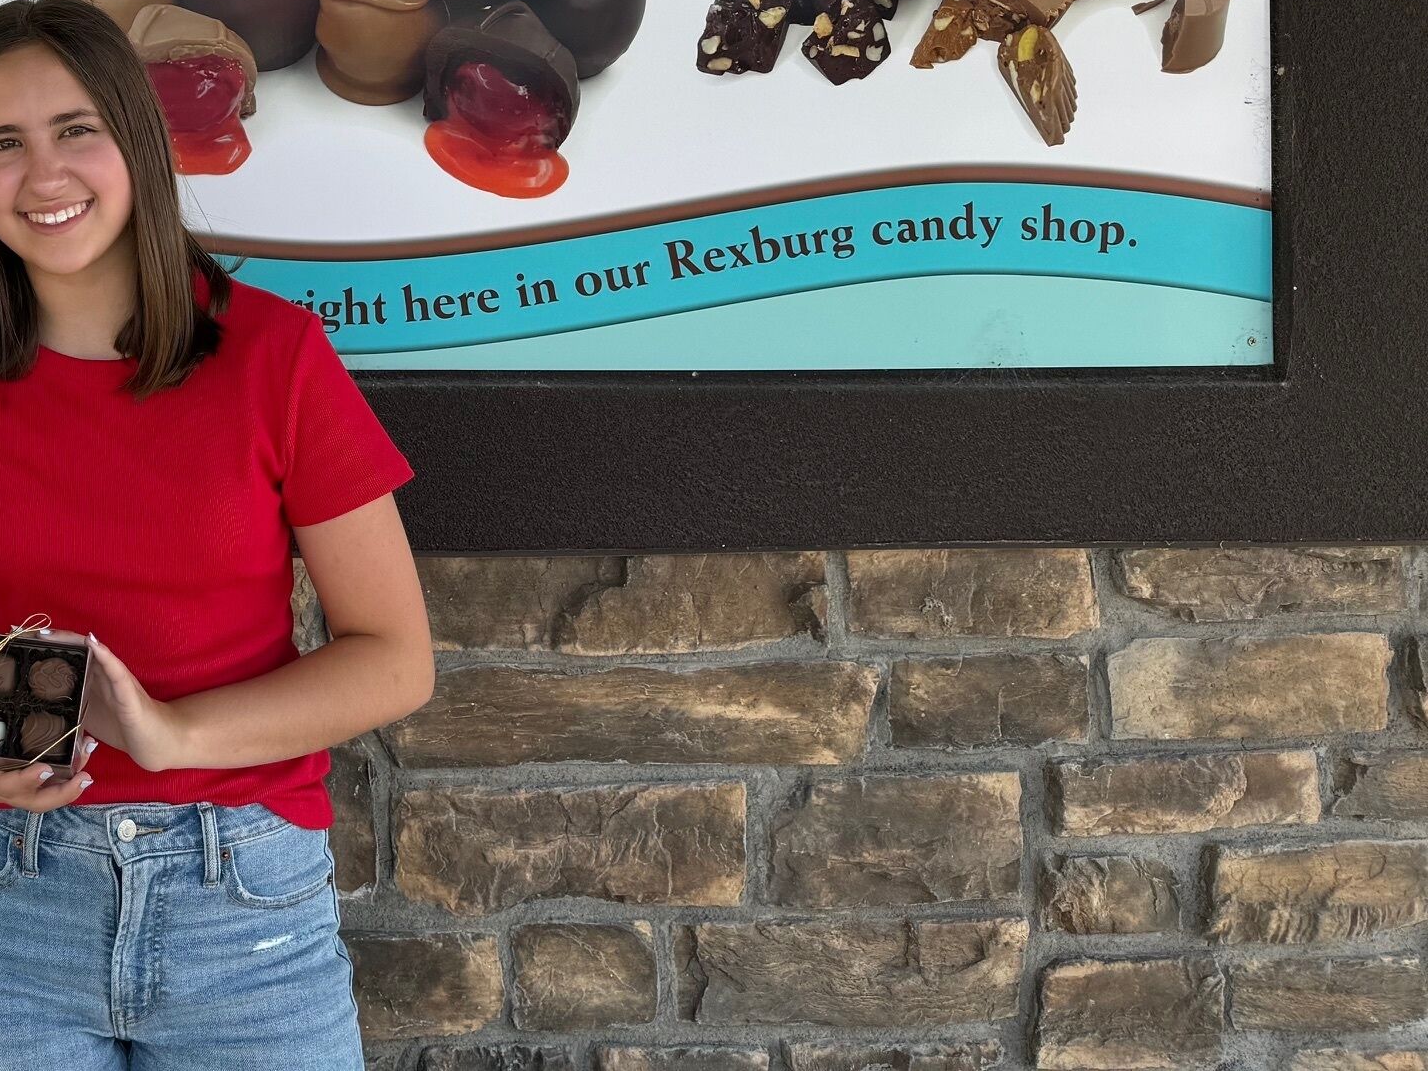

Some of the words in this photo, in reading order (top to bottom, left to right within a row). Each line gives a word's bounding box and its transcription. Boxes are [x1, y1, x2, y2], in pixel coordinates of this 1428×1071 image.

[401, 283, 500, 323] here
[515, 273, 560, 309] in
[574, 259, 650, 297] our
[663, 225, 855, 280] Rexburg
[871, 200, 1003, 249] candy
[1020, 203, 1138, 255] shop.
